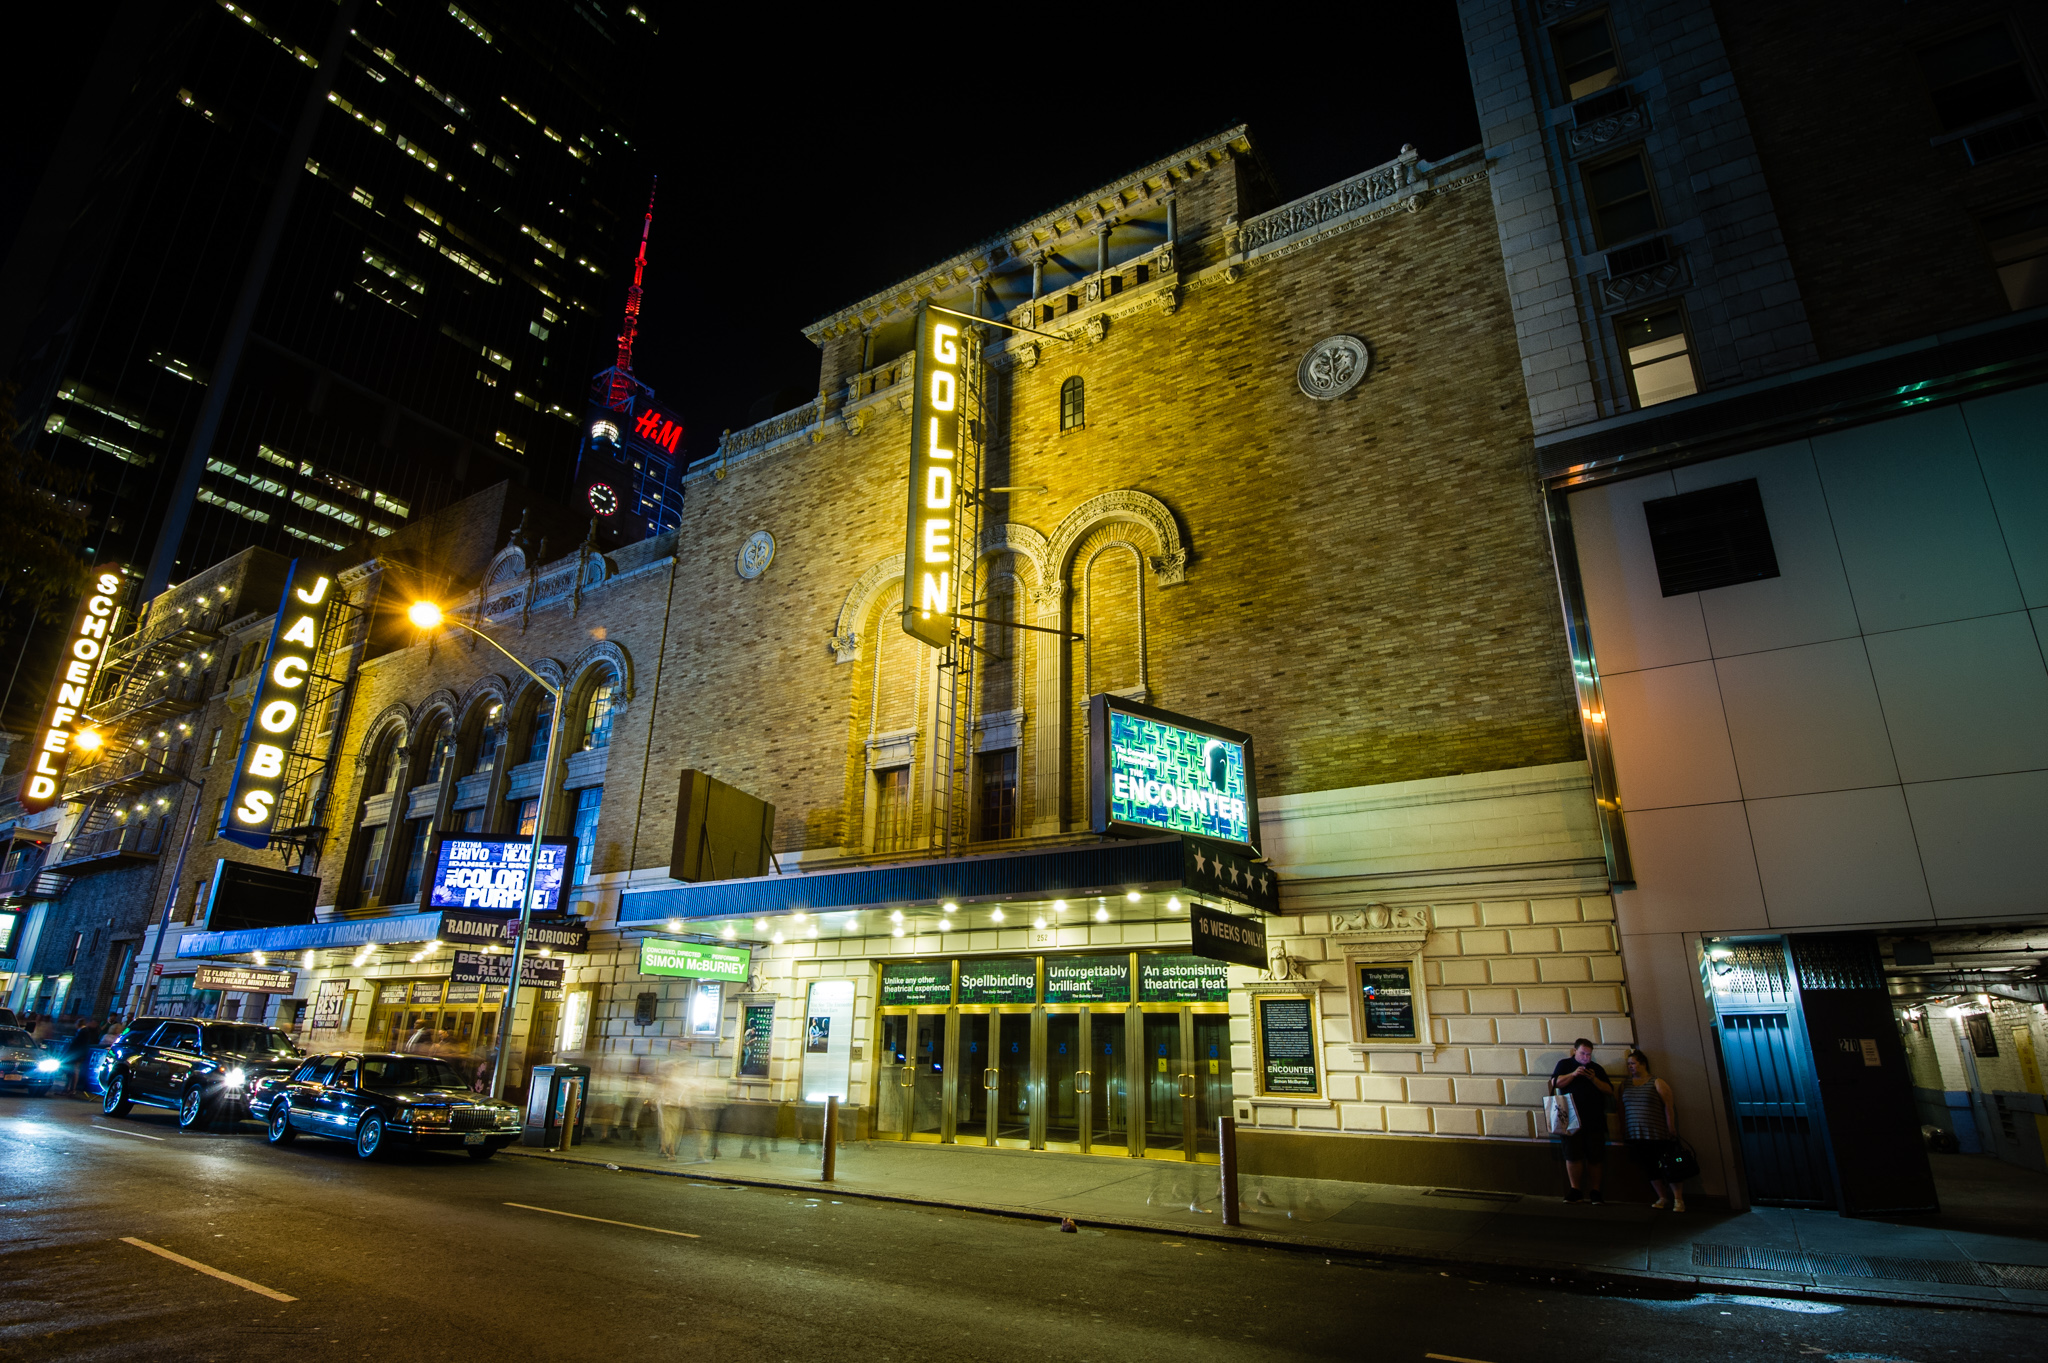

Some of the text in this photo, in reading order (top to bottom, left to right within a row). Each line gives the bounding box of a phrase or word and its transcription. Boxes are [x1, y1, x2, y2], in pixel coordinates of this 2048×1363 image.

[635, 409, 683, 453] H&M
[922, 323, 958, 620] GOLDEN
[28, 574, 120, 799] SCHOENFELD
[237, 576, 330, 824] JACOBS
[1129, 768, 1144, 778] THE
[1114, 773, 1246, 822] ENCOUNTER
[449, 848, 490, 861] ERIVO
[502, 849, 557, 863] HEADEY
[457, 868, 526, 889] COLOR
[463, 888, 550, 909] PURPE!
[240, 932, 260, 949] CALLS
[298, 927, 326, 946] PURPLE
[333, 923, 369, 943] MIRACLE
[370, 922, 382, 940] ON
[1037, 934, 1048, 942] 252
[1199, 917, 1264, 949] 16 WEEKS ONLY!
[458, 953, 560, 971] BEST MSICAL
[646, 947, 677, 956] CONCEIVED,
[677, 950, 701, 958] DIRECTED
[712, 954, 740, 962] PERFORMED
[646, 954, 746, 974] SIMON McBURNEY
[1162, 963, 1229, 978] astonishing
[212, 970, 236, 978] FLOORS
[256, 973, 278, 981] DIRECT
[478, 965, 539, 979] REVIAL
[212, 976, 225, 984] THE
[456, 974, 558, 987] TONY AWAR WINNER!
[905, 978, 917, 986] any
[917, 976, 935, 984] other
[1144, 978, 1199, 989] theatrical
[884, 985, 914, 993] theatrical
[316, 996, 344, 1014] BEST
[1840, 1039, 1858, 1051] 270
[1267, 1065, 1314, 1074] ENCOUNTER
